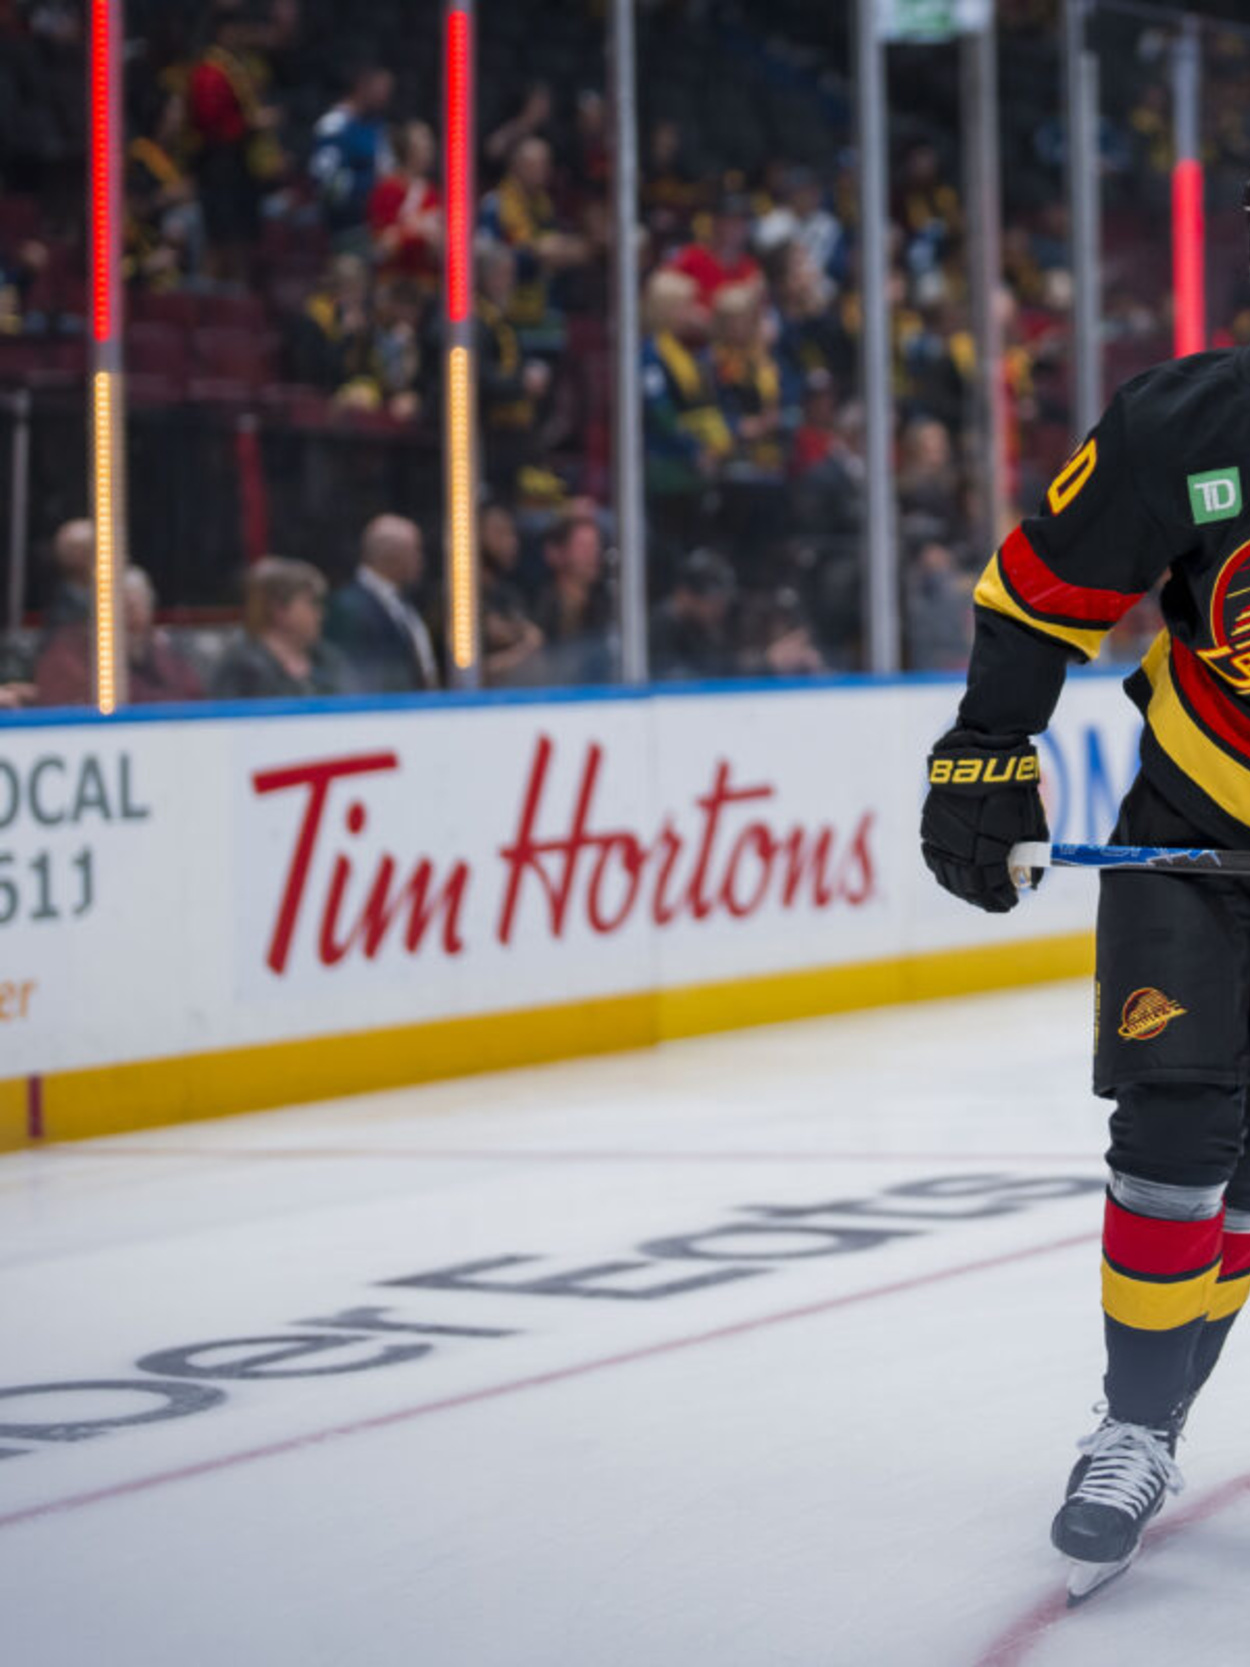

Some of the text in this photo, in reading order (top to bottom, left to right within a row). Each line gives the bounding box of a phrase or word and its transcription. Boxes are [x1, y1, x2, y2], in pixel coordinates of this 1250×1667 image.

[1193, 478, 1237, 512] TD
[929, 755, 1040, 785] BAUE
[252, 751, 470, 978] Tim
[498, 732, 878, 947] Hortons
[372, 1171, 1108, 1300] Eats
